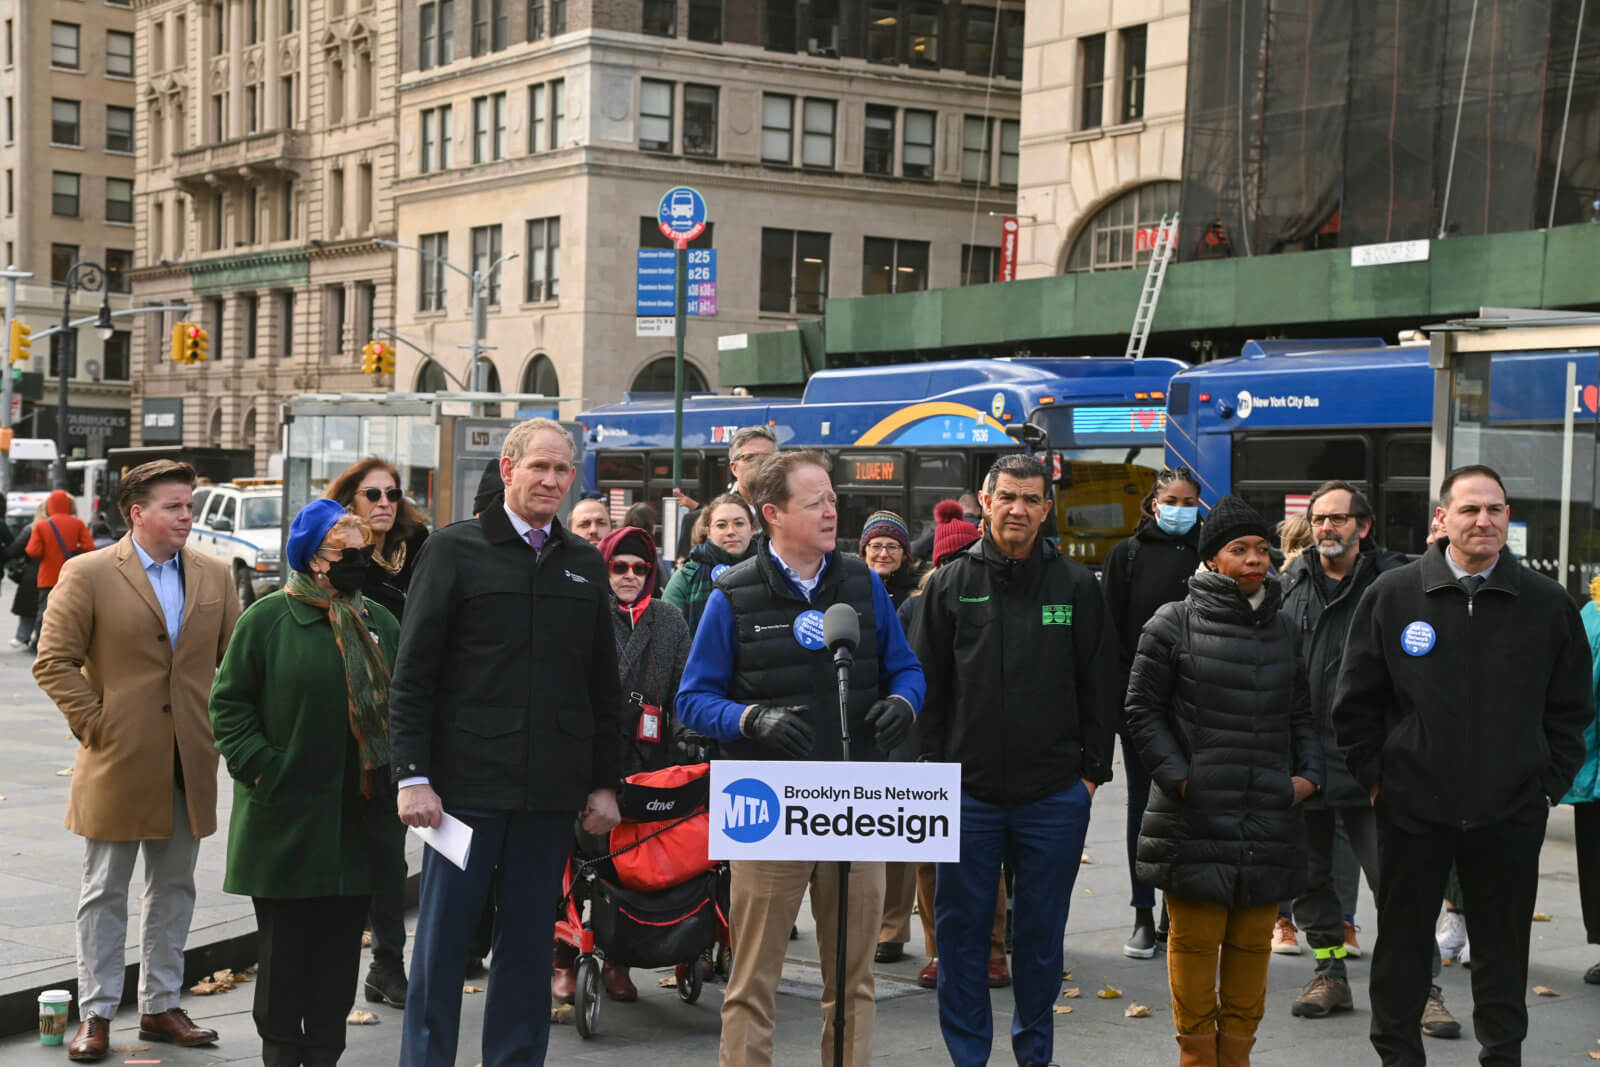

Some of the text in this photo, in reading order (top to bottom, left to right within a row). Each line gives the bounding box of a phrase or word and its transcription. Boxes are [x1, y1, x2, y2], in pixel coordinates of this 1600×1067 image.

[688, 251, 710, 263] B25
[688, 267, 710, 280] B26
[1253, 396, 1269, 408] New
[1270, 396, 1286, 408] York
[1287, 395, 1303, 409] City
[1304, 395, 1320, 408] Bus
[57, 414, 126, 427] ARBUCKS
[882, 463, 894, 480] NY
[646, 798, 674, 811] drive
[722, 785, 948, 830] MTA Brooklyn Bus Network
[784, 805, 949, 844] Redesign
